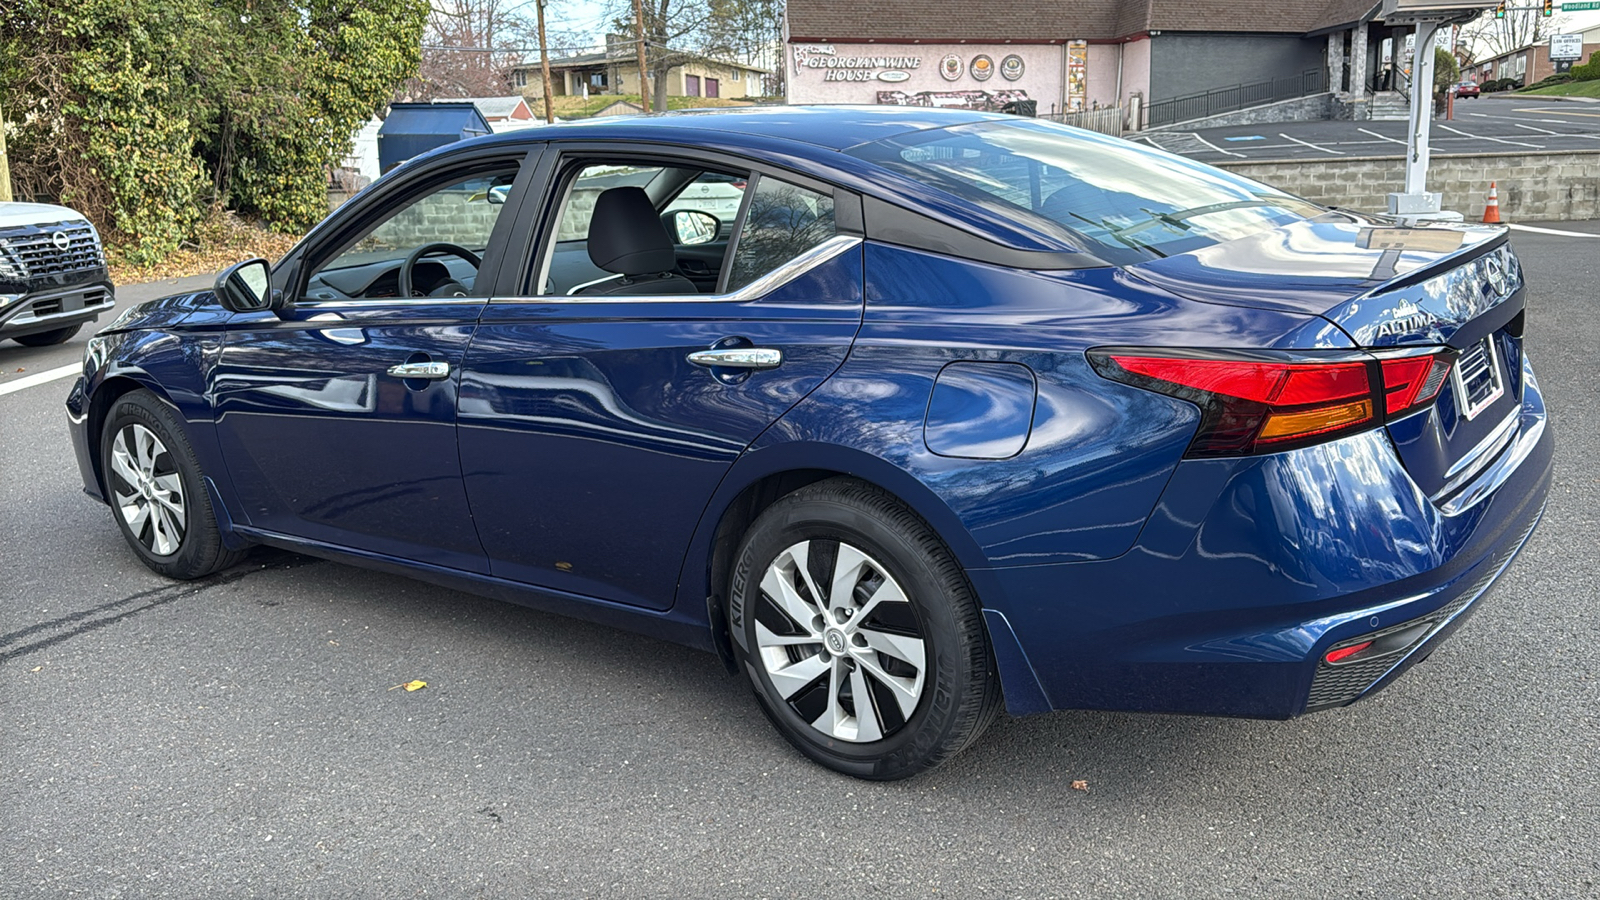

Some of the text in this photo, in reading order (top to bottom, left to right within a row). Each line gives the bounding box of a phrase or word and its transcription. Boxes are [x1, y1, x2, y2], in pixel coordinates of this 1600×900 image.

[808, 56, 922, 69] GEORGIAN WINE
[824, 69, 872, 82] HOUSE
[1377, 312, 1438, 338] ALTIMA
[731, 539, 757, 629] KINERGY
